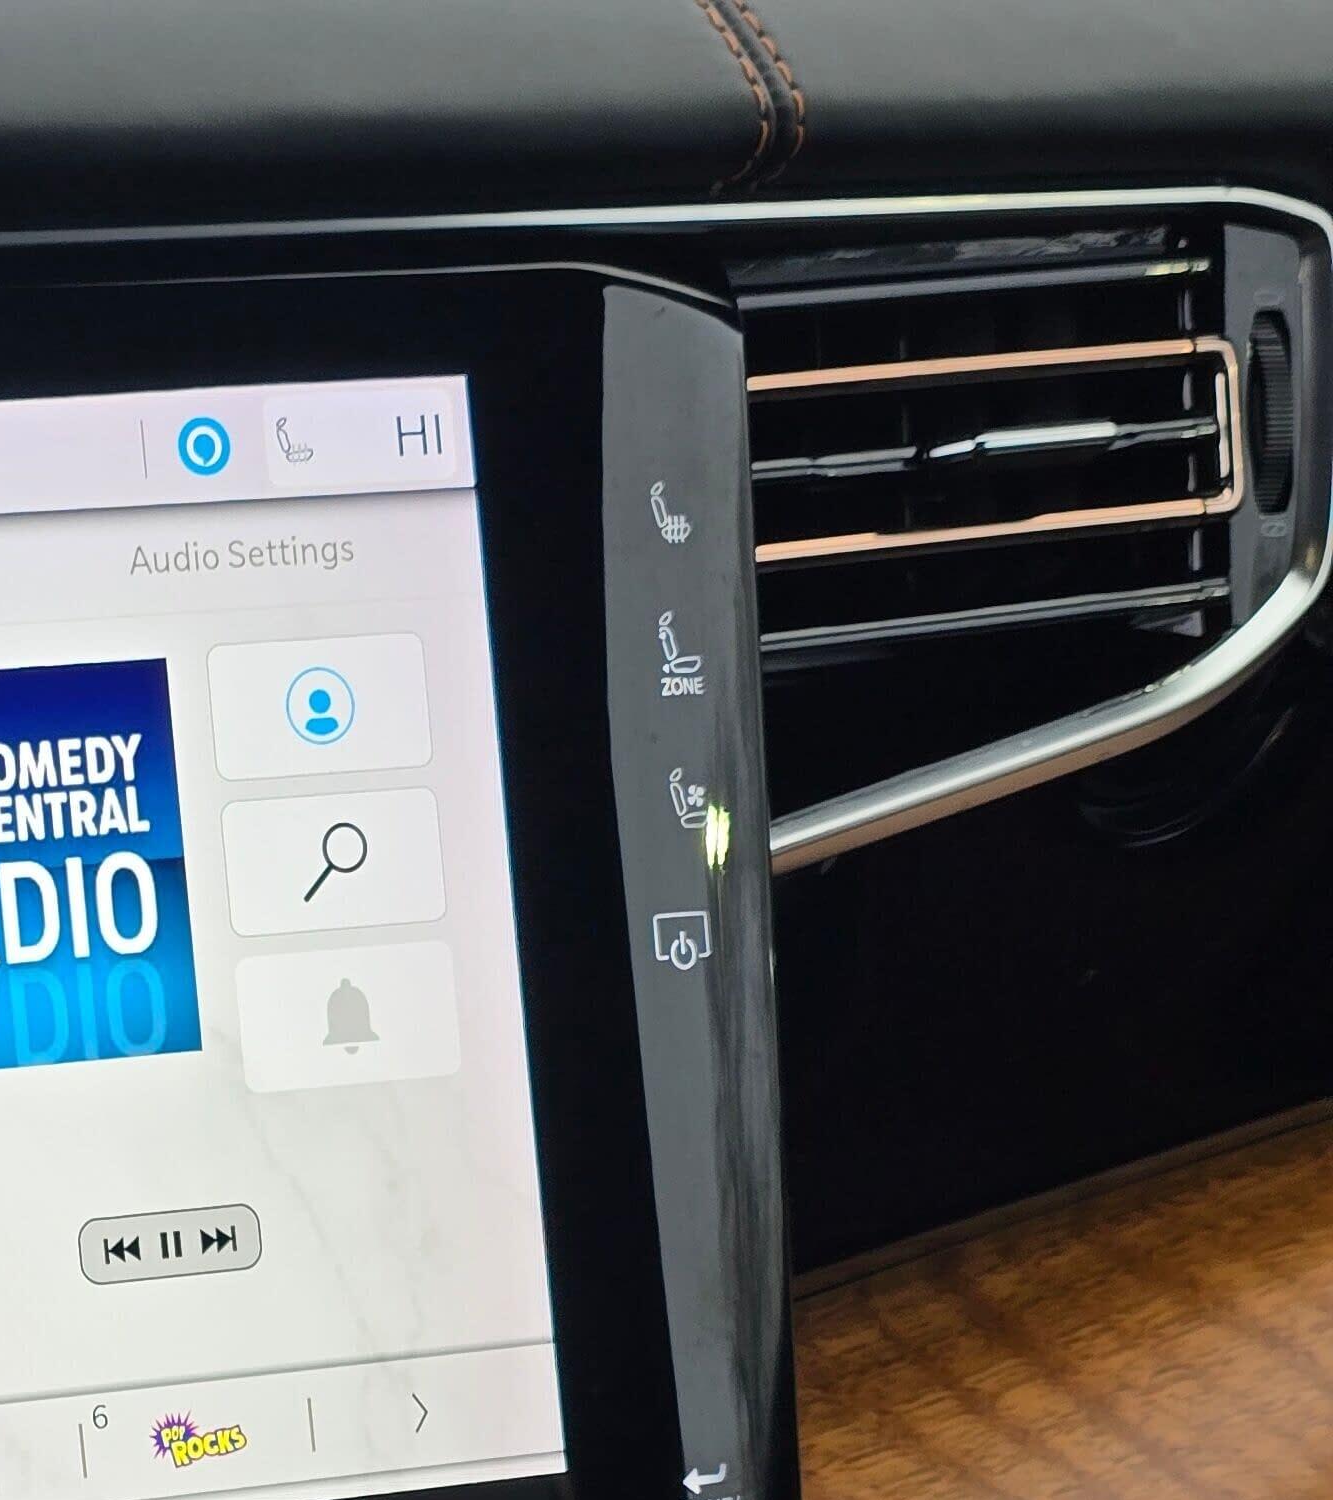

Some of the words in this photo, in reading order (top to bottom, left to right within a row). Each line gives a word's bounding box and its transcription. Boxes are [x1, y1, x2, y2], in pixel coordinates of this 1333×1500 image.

[395, 413, 444, 458] HI
[130, 540, 220, 576] Audio
[228, 536, 355, 570] Settings
[661, 676, 705, 696] ZONE
[92, 1406, 109, 1430] 6
[171, 1425, 247, 1468] ROCKS
